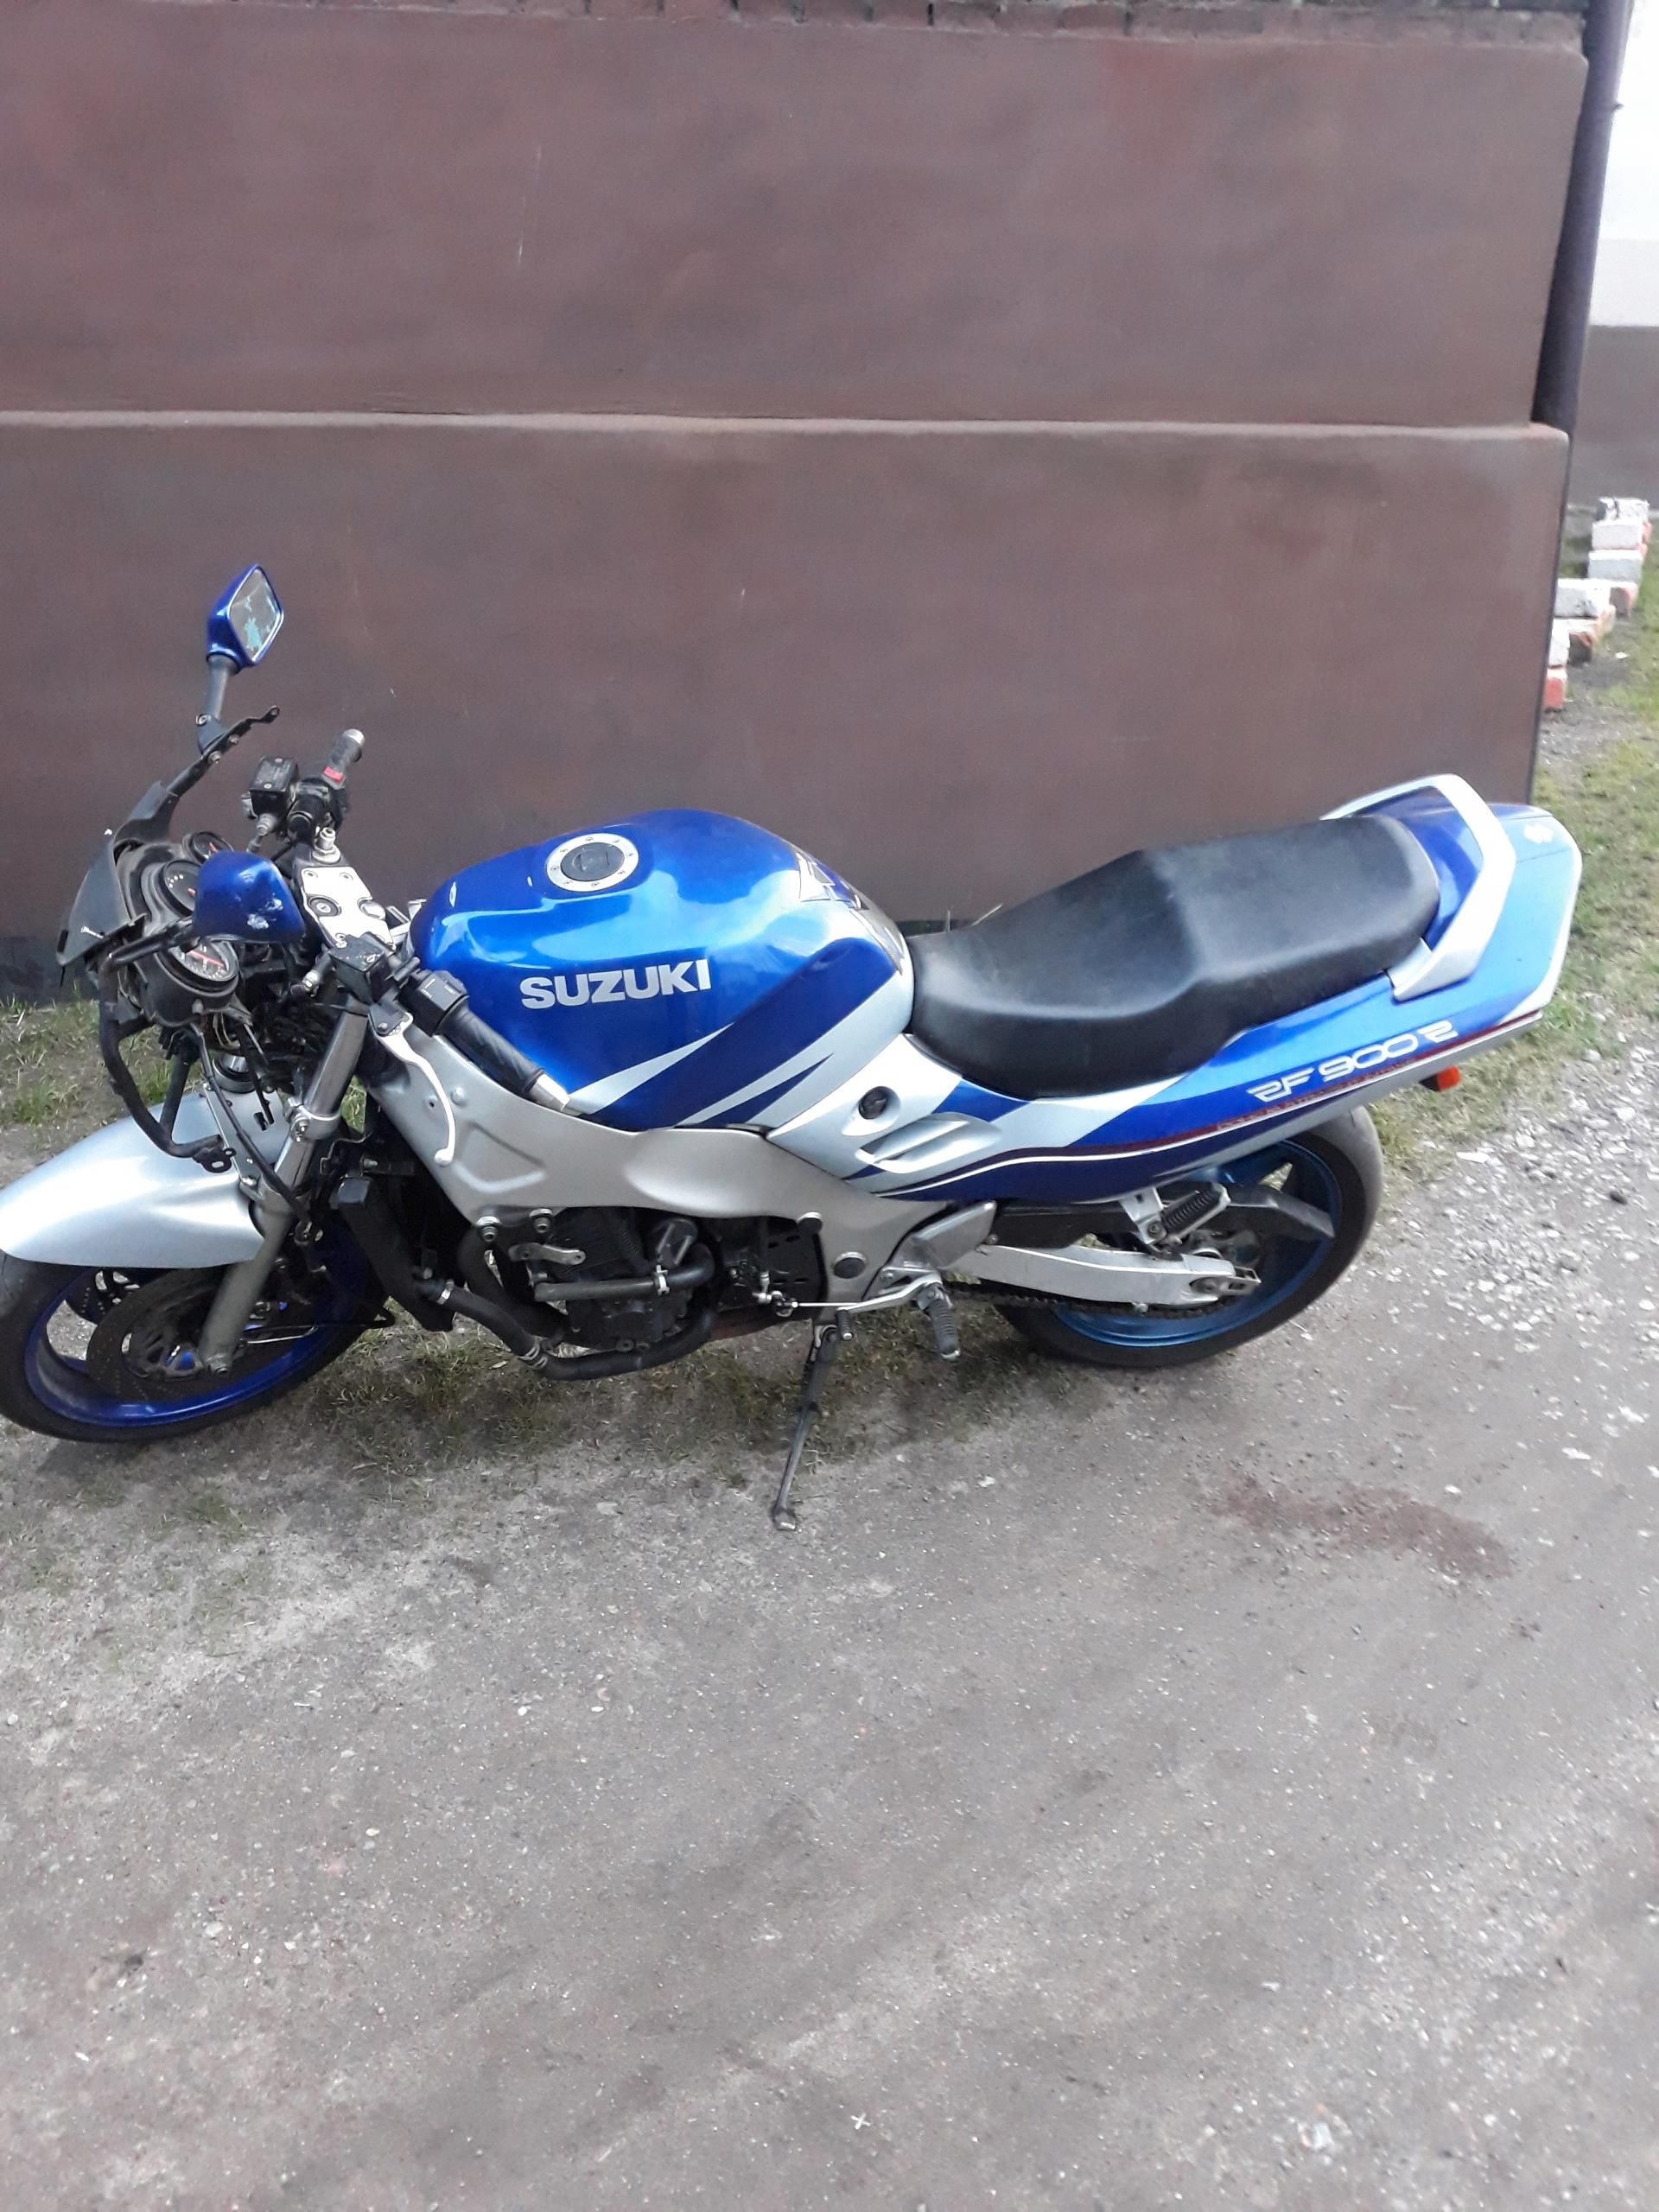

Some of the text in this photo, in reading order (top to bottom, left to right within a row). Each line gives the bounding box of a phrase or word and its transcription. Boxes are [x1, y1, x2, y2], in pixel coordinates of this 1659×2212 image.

[520, 958, 711, 1009] SUZUKI
[1246, 1067, 1315, 1103] RF
[1318, 1033, 1419, 1083] 900
